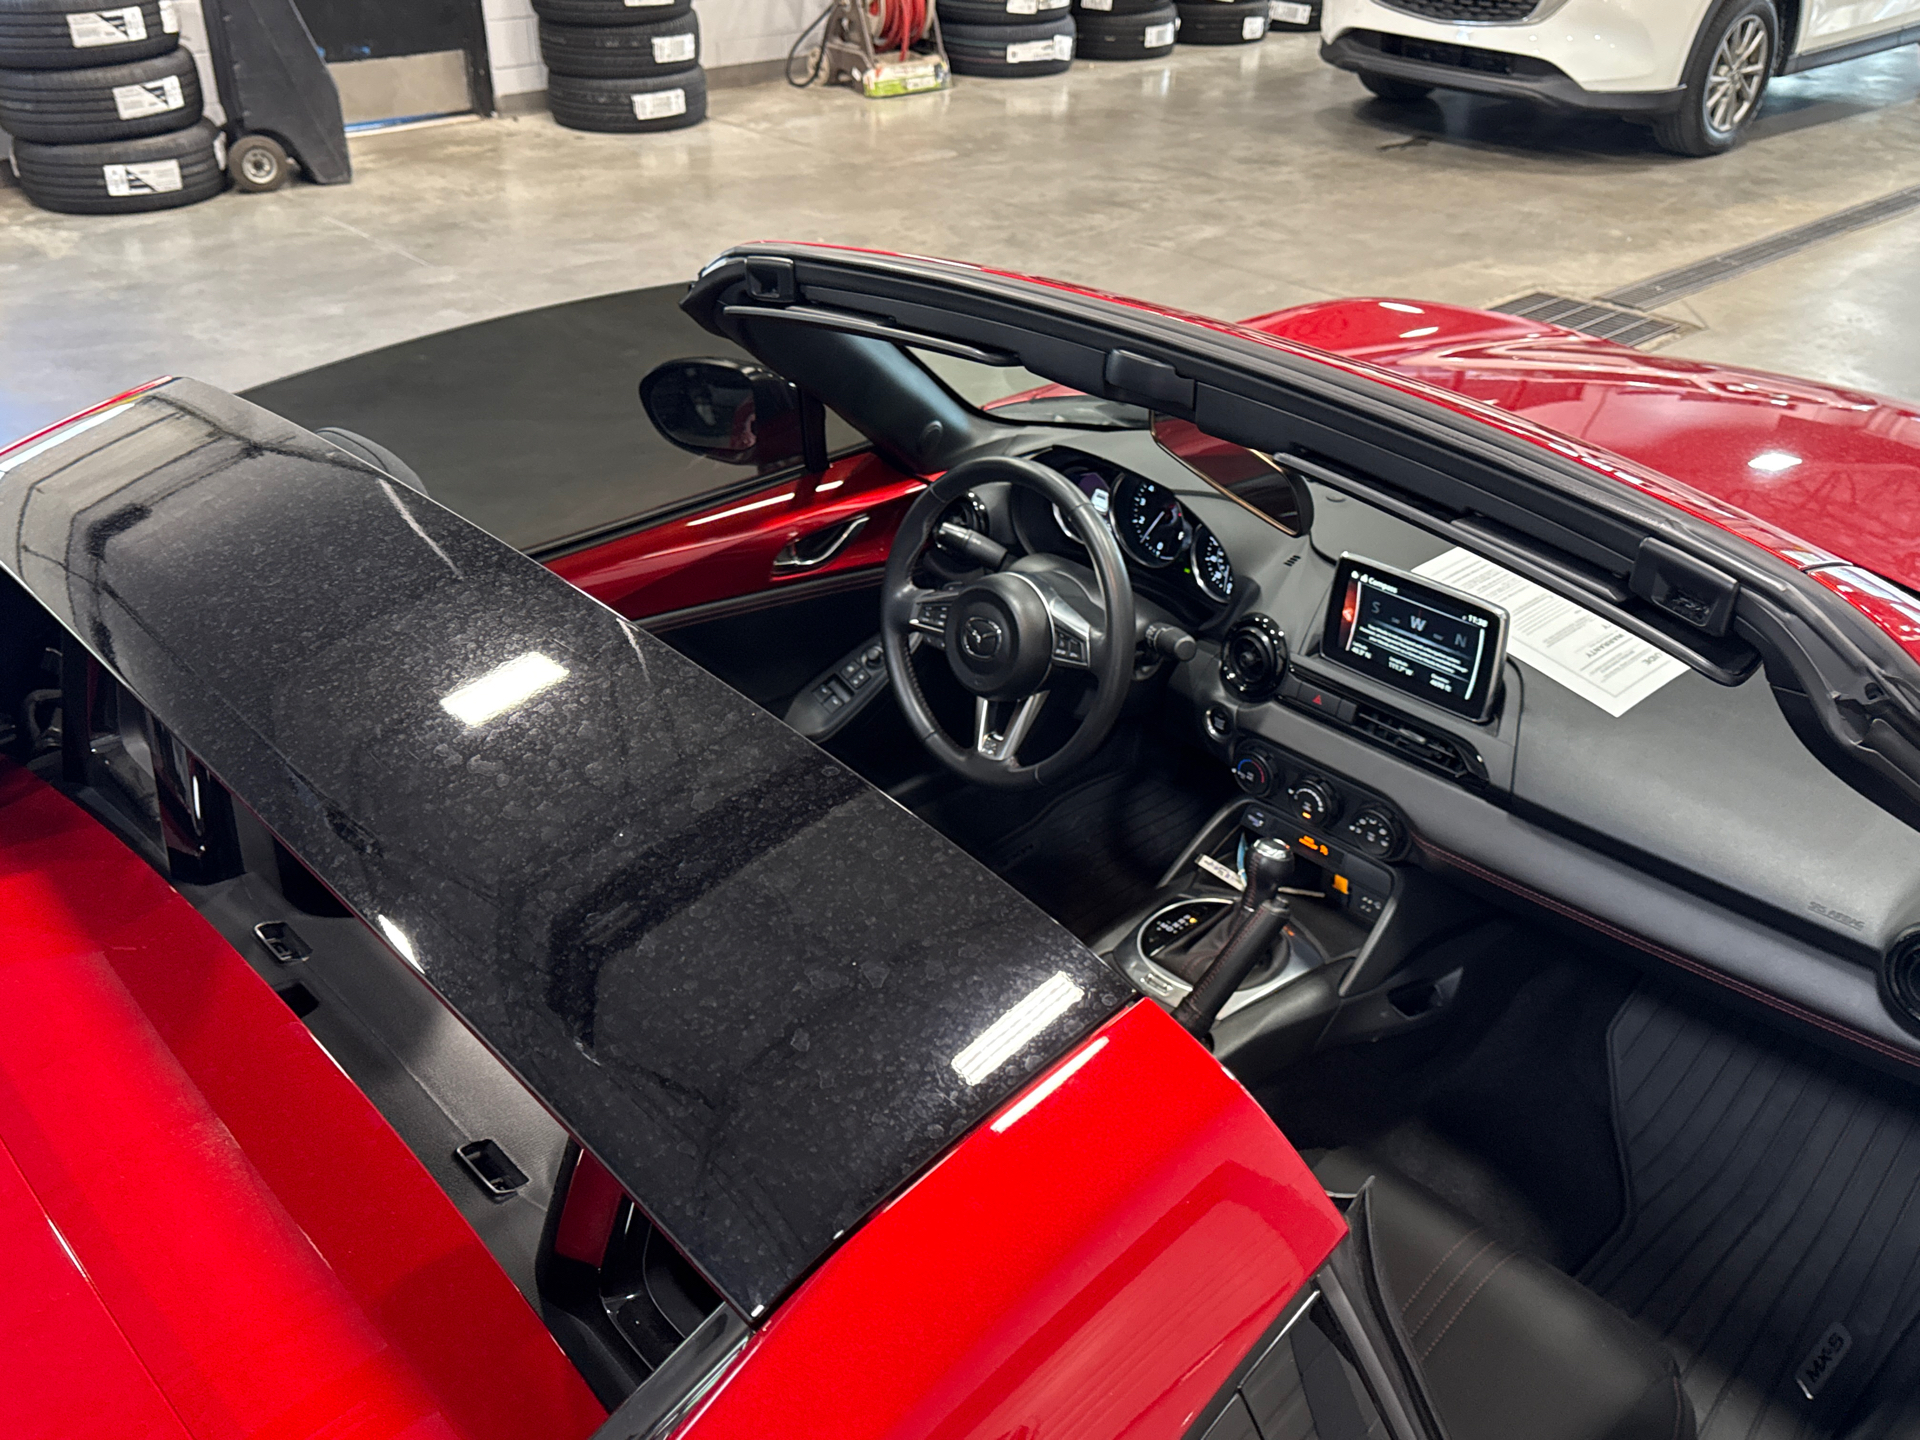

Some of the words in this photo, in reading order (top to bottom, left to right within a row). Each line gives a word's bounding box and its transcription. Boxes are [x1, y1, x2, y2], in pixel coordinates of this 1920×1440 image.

[1371, 601, 1381, 614] S
[1410, 615, 1427, 632] W
[1454, 633, 1468, 648] N
[1585, 633, 1625, 659] WARRANTY
